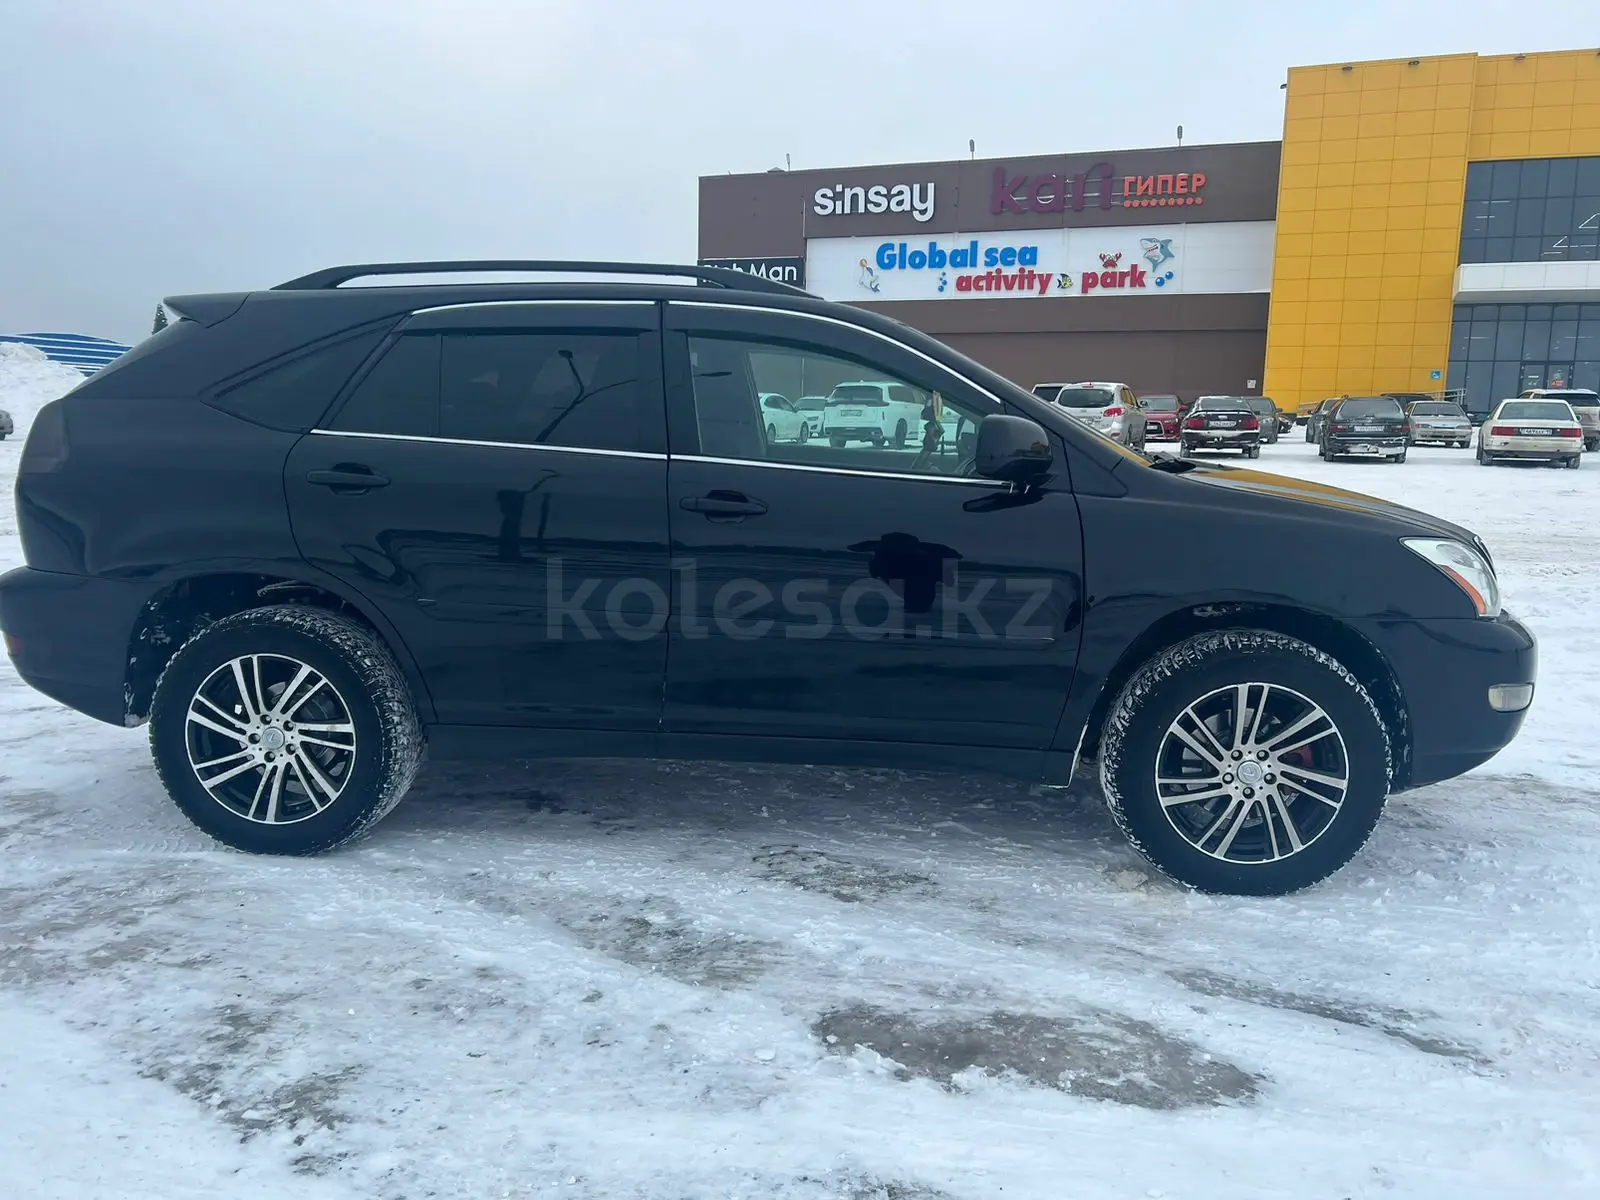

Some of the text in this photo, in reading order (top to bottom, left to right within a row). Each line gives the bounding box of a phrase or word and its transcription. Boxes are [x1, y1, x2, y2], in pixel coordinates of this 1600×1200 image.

[991, 162, 1115, 215] kari
[1122, 171, 1207, 197] ГИПЕР
[813, 182, 935, 222] sinsay
[875, 240, 1038, 270] Global sea
[749, 262, 797, 281] Man
[955, 264, 1146, 294] activity park
